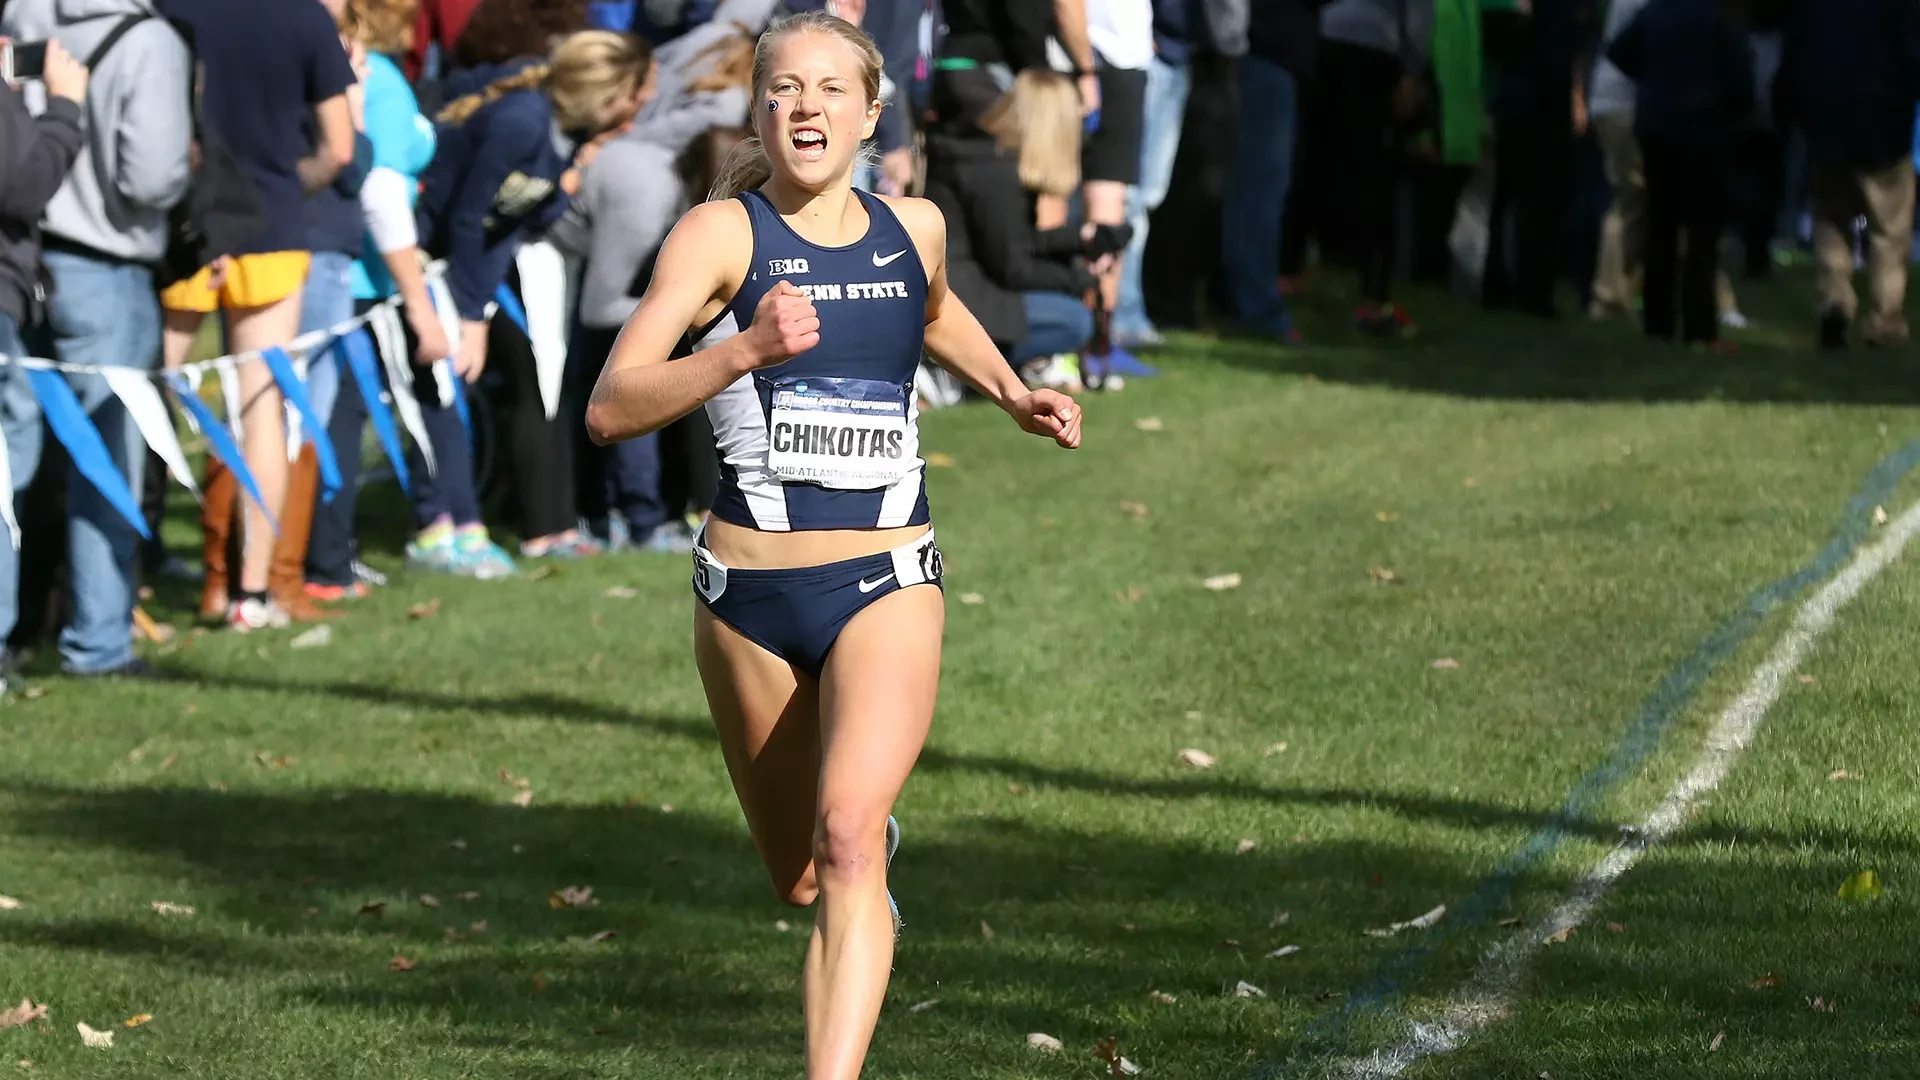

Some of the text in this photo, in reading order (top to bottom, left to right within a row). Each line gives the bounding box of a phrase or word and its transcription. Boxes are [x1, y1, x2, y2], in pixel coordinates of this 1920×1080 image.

[794, 281, 908, 301] ENN STATE
[819, 397, 851, 408] COUNTRY
[773, 421, 903, 459] CHIKOTAS
